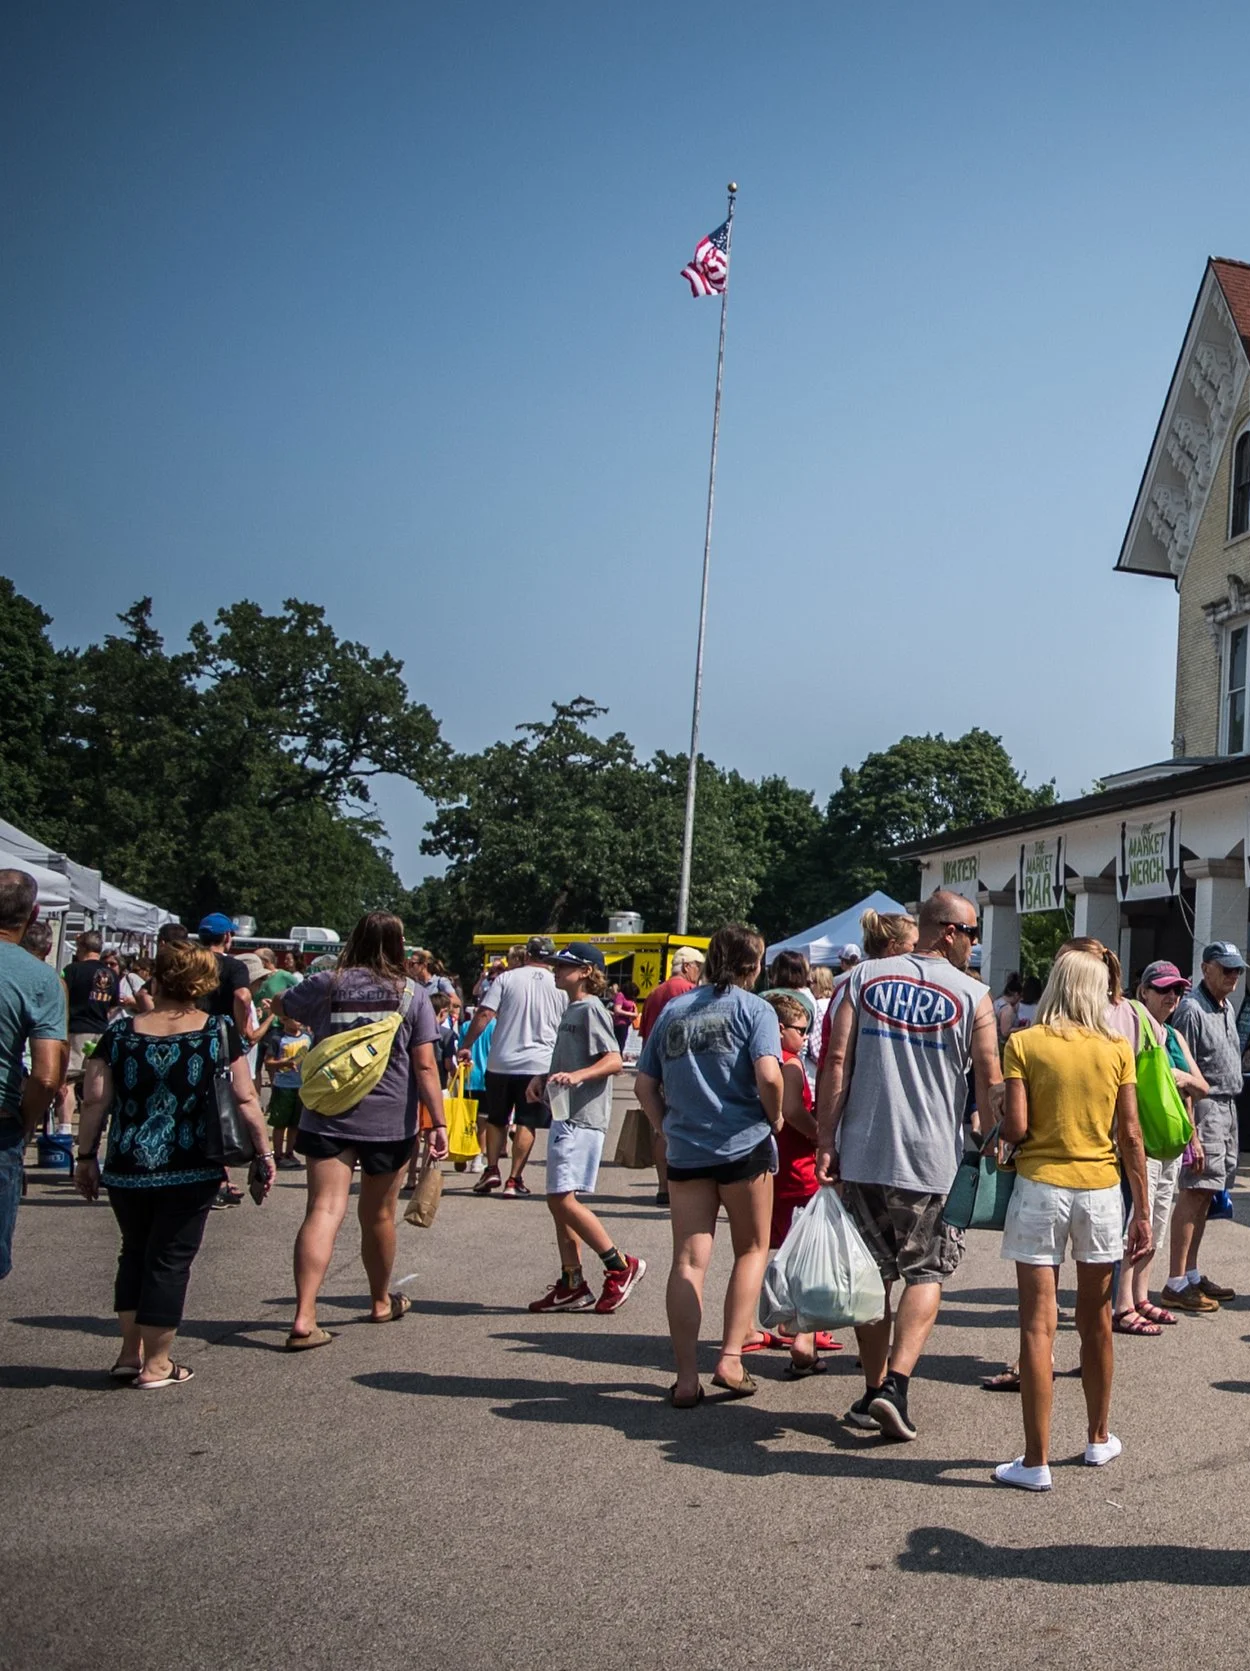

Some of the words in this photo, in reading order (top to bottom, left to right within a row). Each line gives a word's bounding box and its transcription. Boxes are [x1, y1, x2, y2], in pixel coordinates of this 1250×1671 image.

[1141, 822, 1153, 835] THE
[1129, 832, 1166, 857] MARKET
[943, 856, 977, 885] WATER
[1026, 855, 1053, 874] MARKET
[1129, 857, 1164, 887] MERCH
[1025, 873, 1052, 909] BAR
[873, 984, 946, 1023] NHRA
